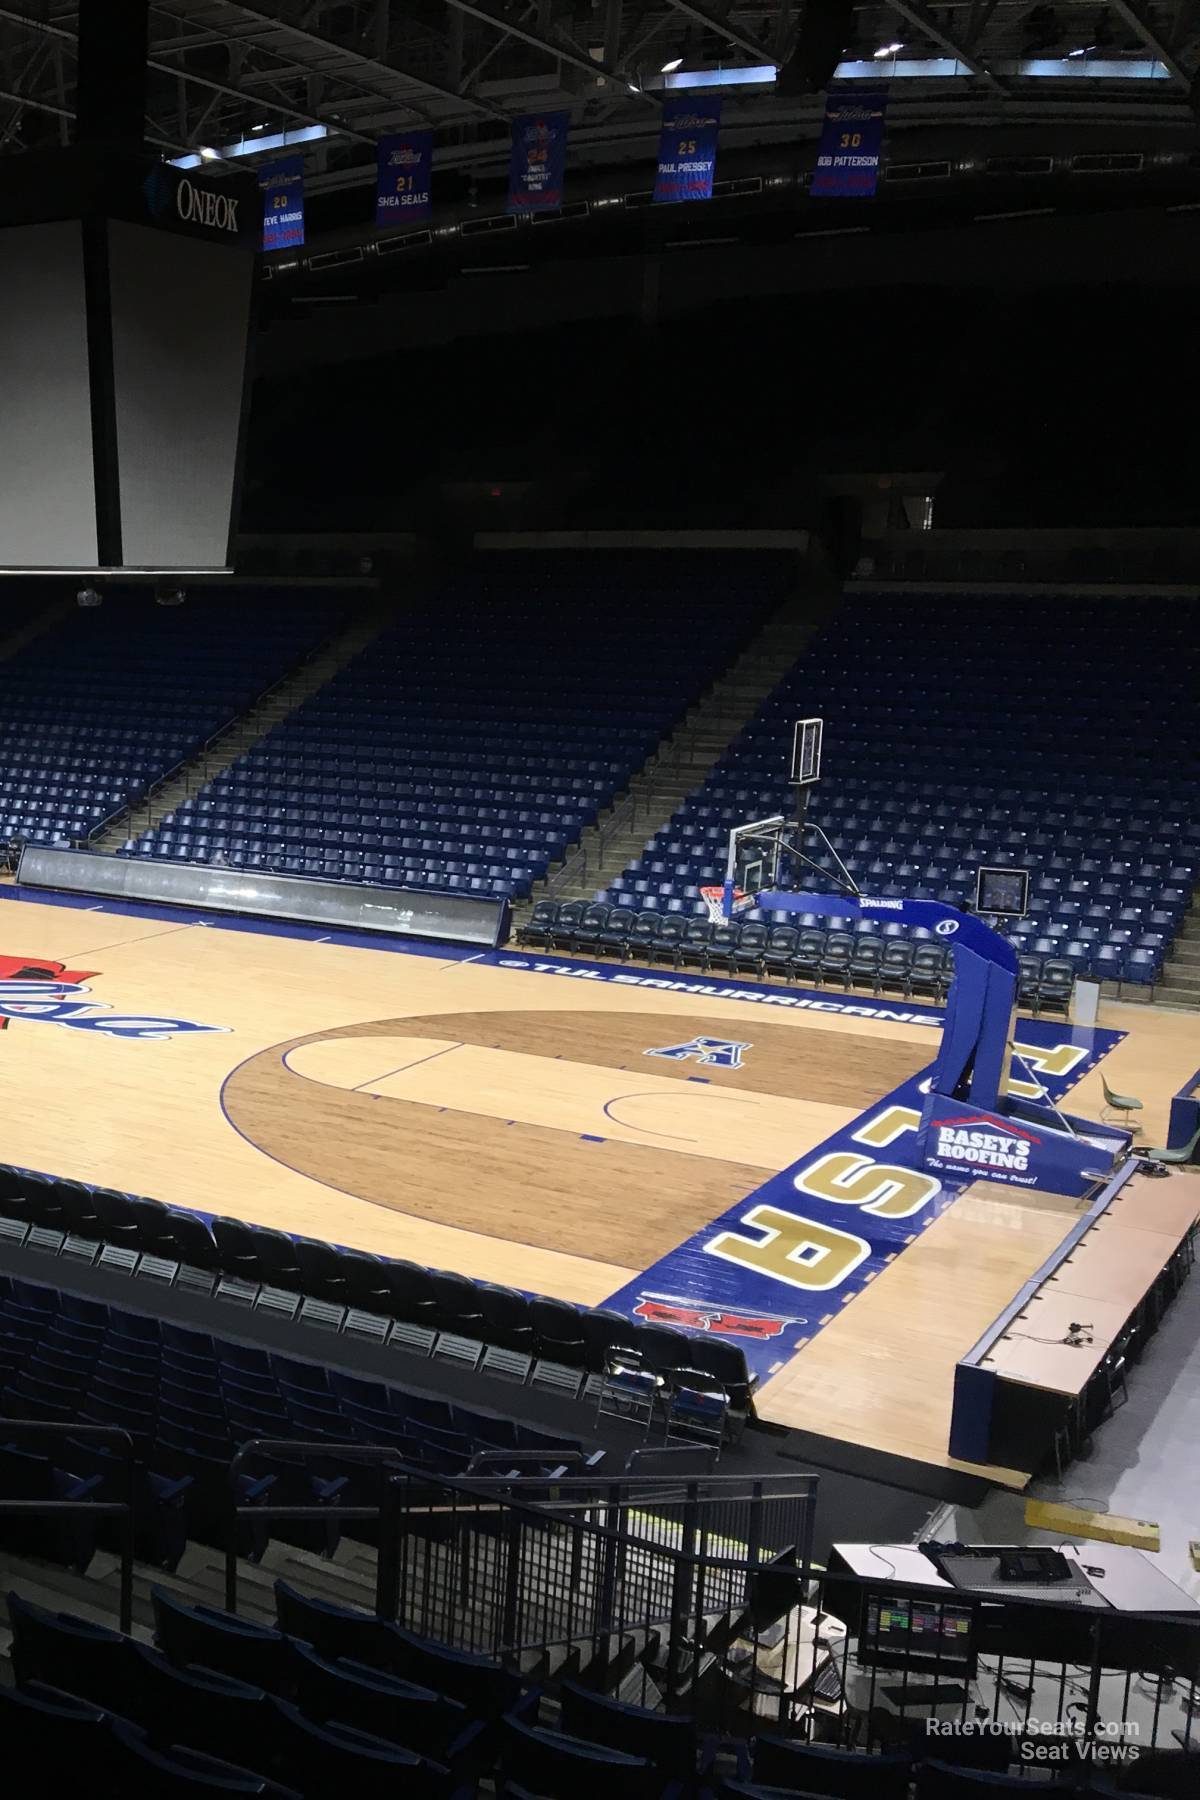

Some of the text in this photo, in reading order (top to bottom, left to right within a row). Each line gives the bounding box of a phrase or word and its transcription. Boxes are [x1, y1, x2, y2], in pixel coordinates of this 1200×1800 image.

[678, 140, 696, 155] 25
[658, 161, 712, 174] PAUL PRESSEY
[396, 176, 413, 192] 21
[176, 179, 240, 232] ONEOK
[273, 195, 287, 208] 20
[377, 192, 429, 208] SHEA SEALS
[859, 898, 904, 911] SPALDING
[939, 1126, 1031, 1156] BASEY'S
[937, 1142, 1029, 1171] ROOFING
[926, 1158, 1038, 1185] The name you can trust!
